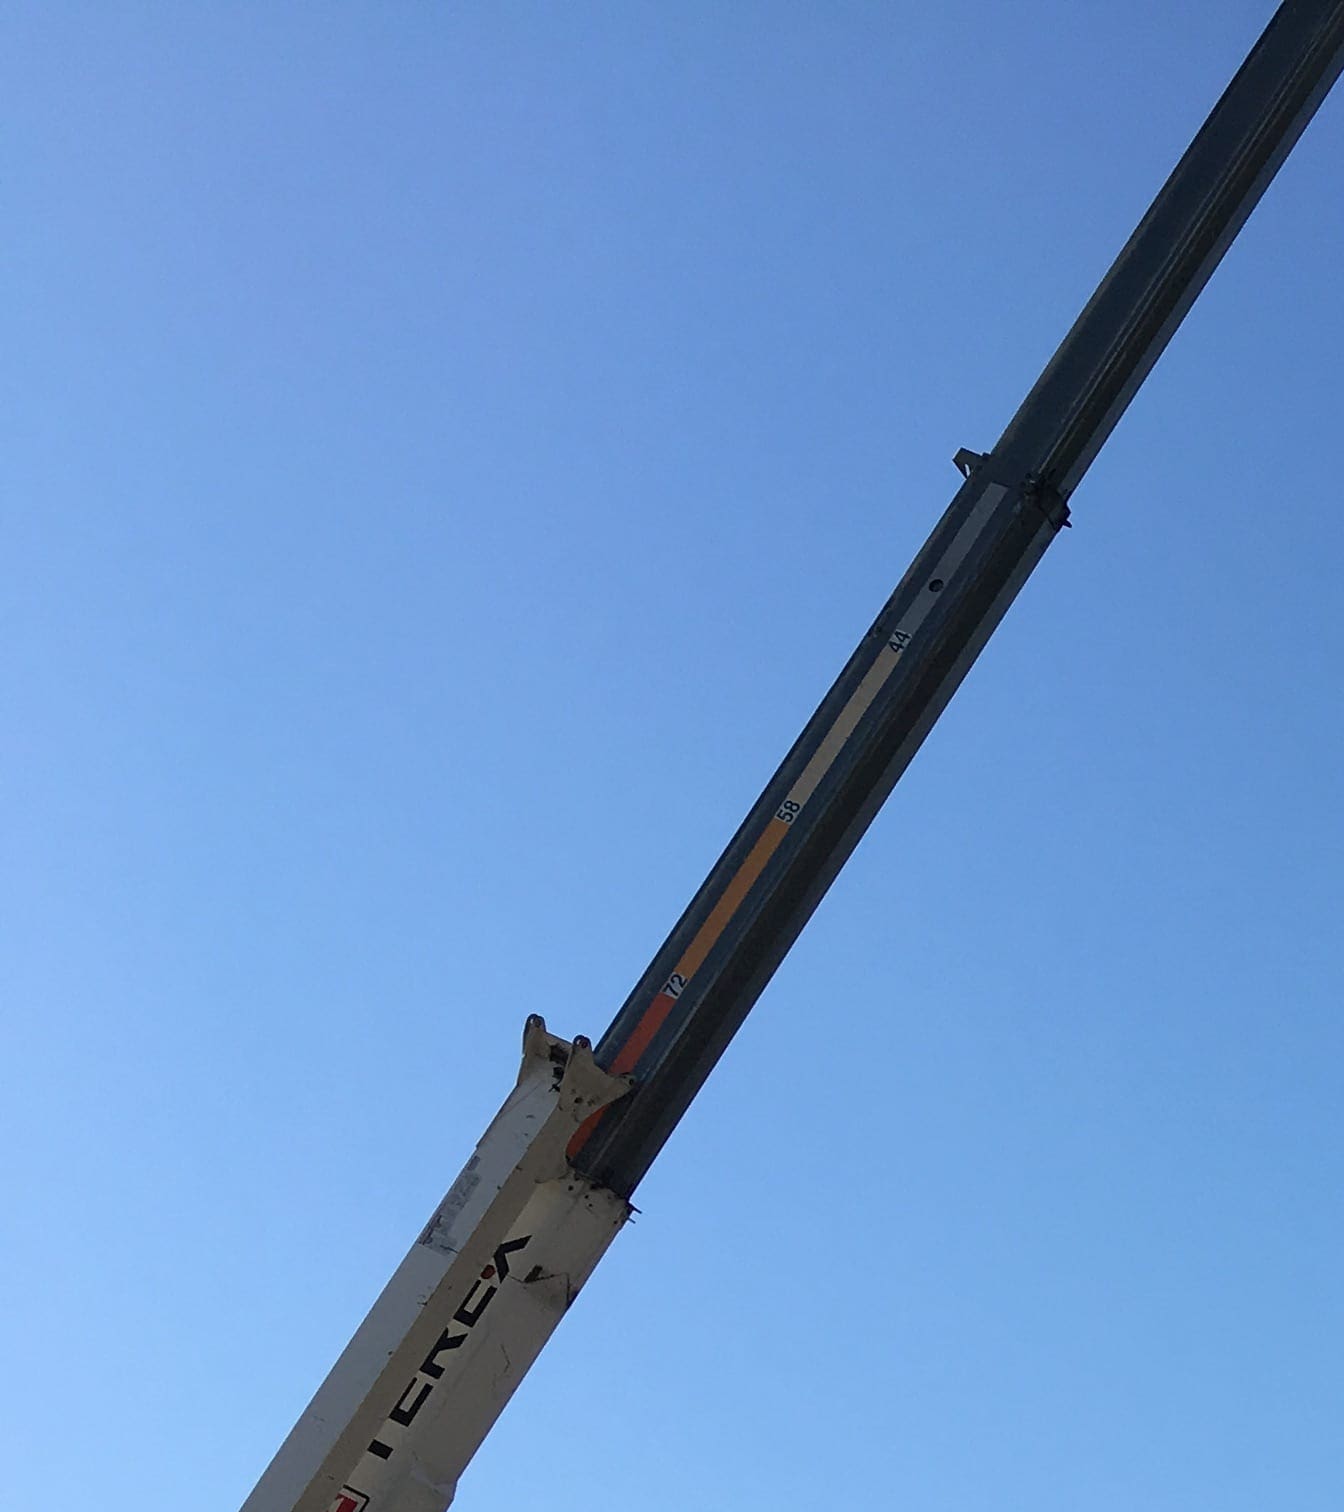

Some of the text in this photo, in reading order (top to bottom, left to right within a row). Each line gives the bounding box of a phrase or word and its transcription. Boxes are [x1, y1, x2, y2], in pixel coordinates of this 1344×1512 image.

[888, 629, 911, 654] 44
[776, 800, 800, 824] 58
[662, 973, 688, 999] 72
